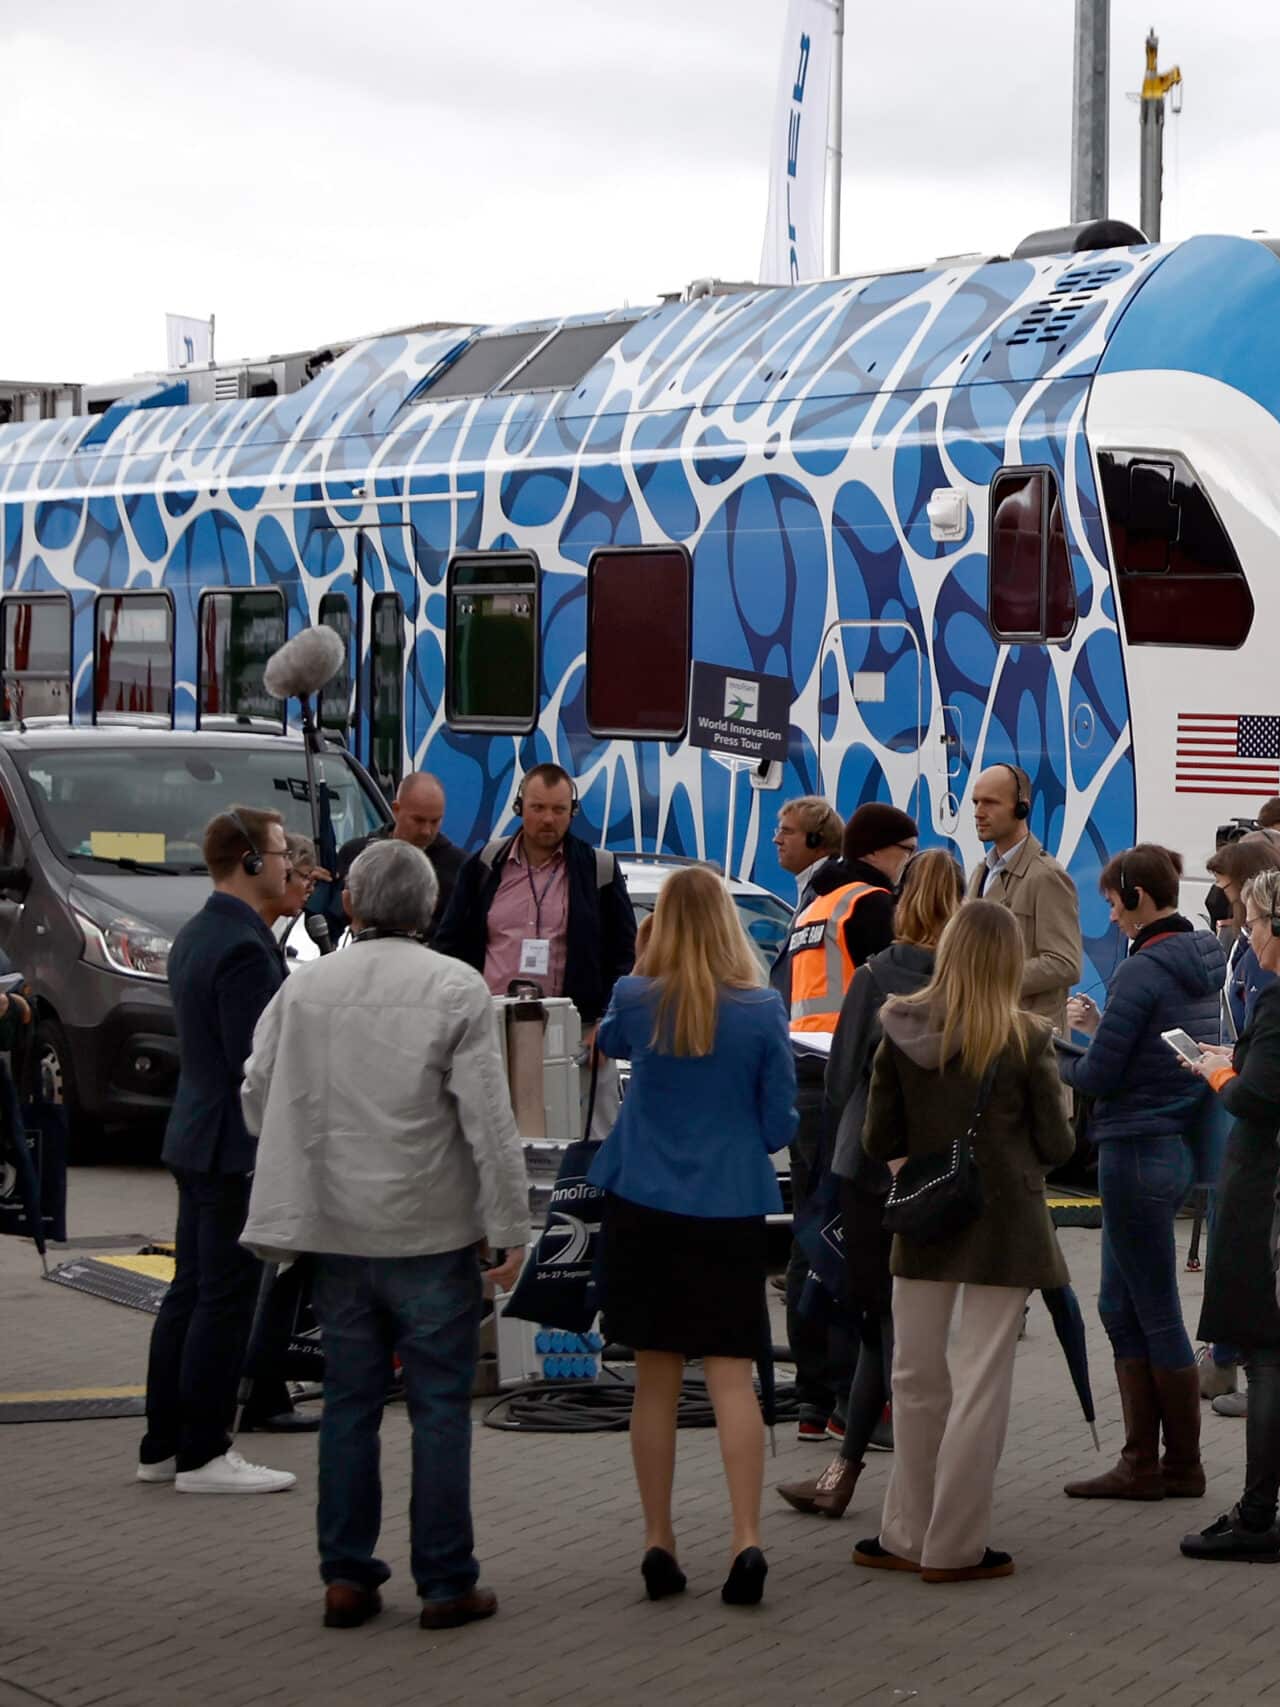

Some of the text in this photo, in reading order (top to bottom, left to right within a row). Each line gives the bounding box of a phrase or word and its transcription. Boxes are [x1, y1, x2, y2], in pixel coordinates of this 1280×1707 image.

[698, 716, 782, 740] World Innovation
[714, 733, 762, 750] Press Tour
